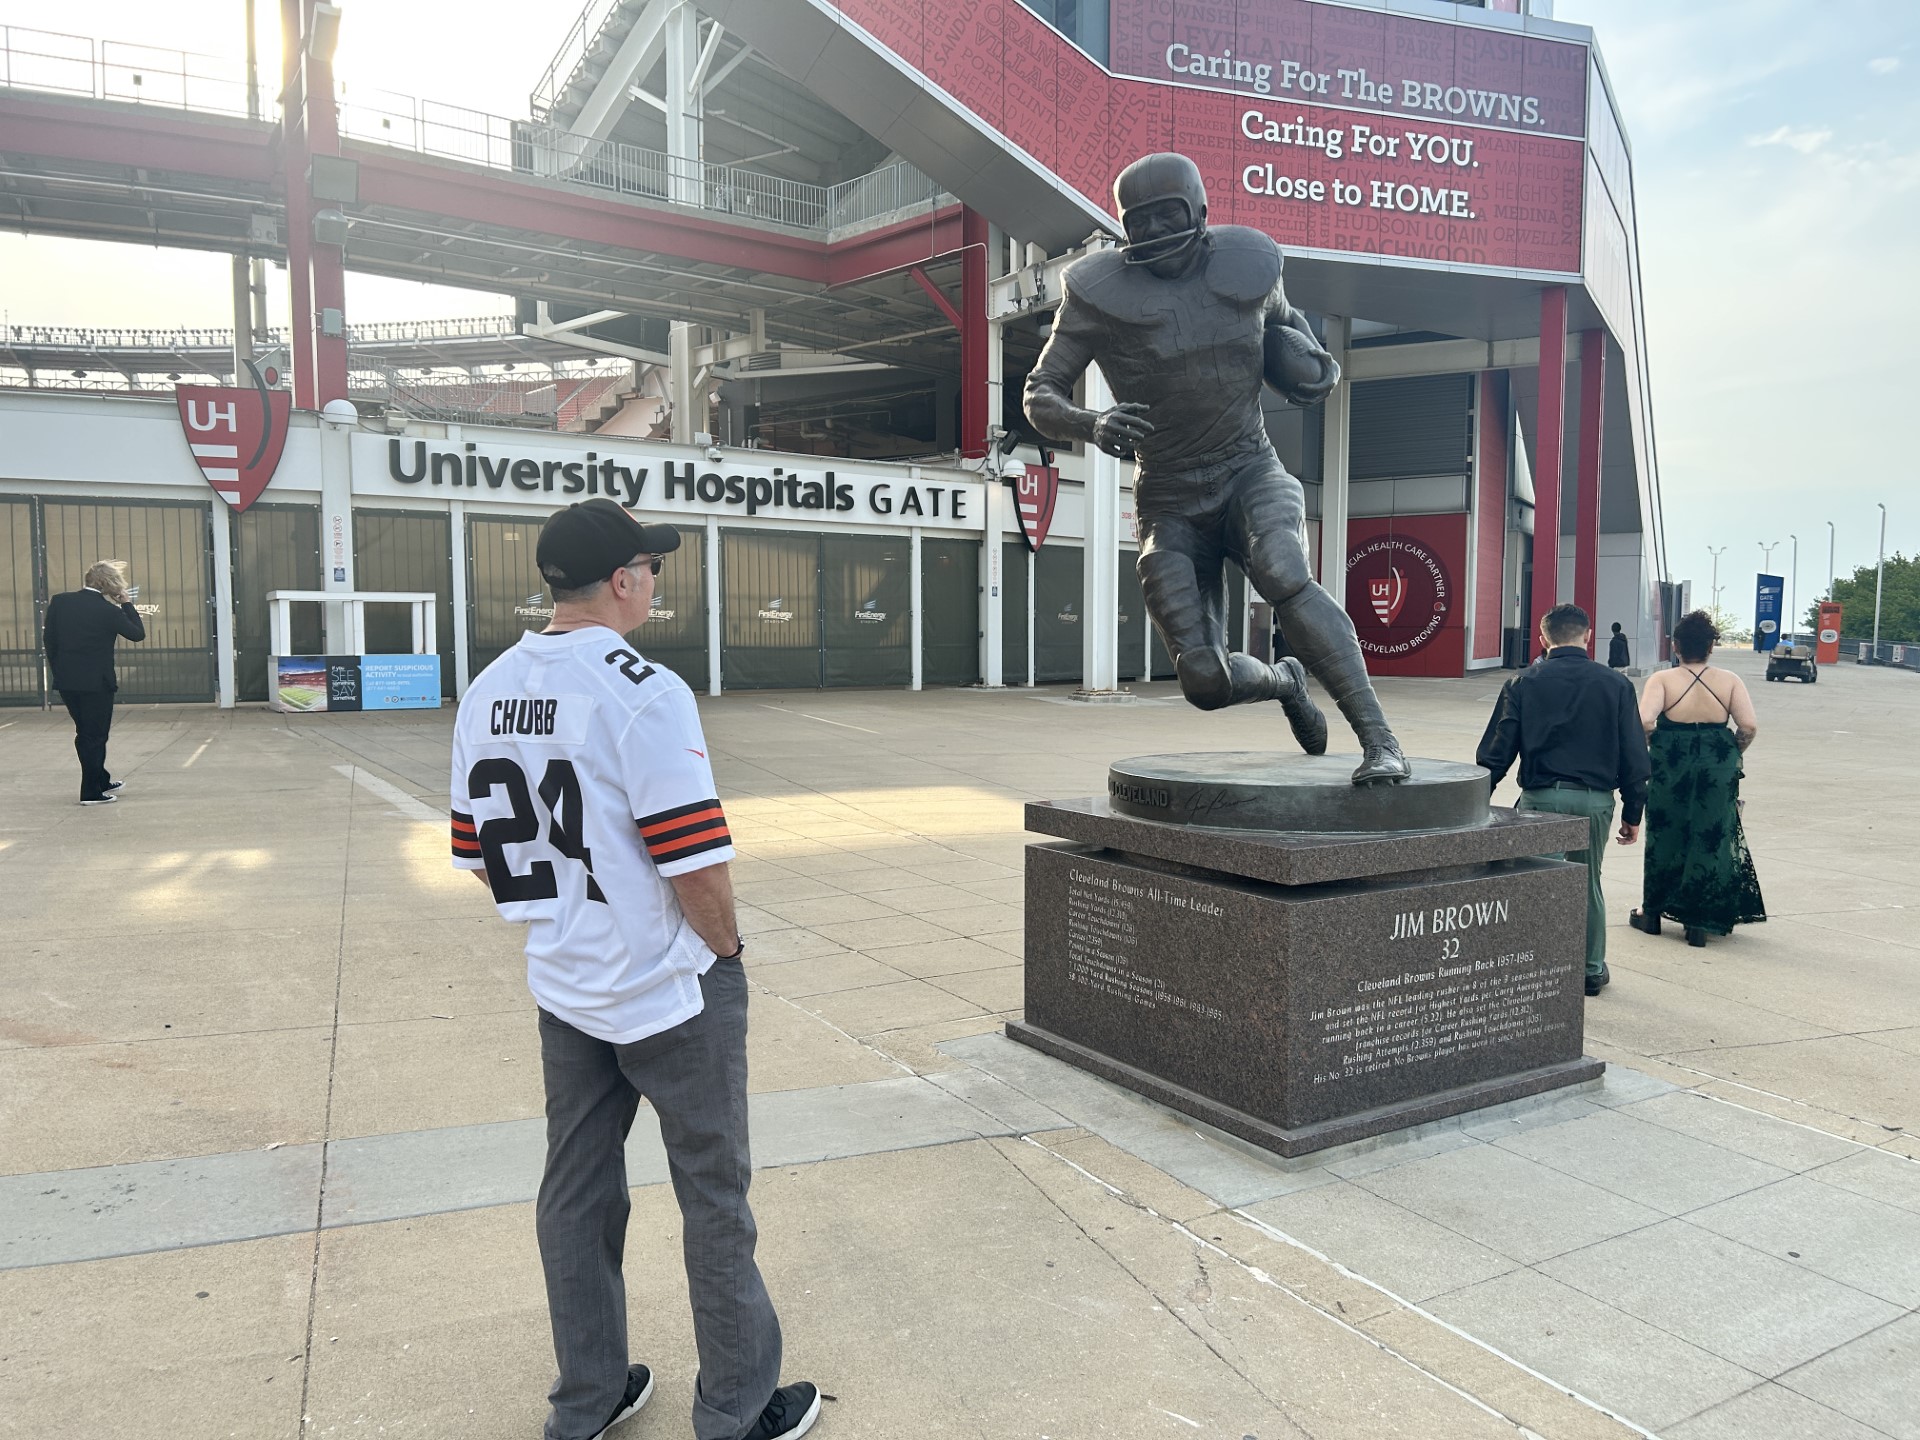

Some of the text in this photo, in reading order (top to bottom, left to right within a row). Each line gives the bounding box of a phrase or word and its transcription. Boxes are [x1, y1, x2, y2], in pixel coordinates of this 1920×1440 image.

[934, 0, 979, 68] SANDUS
[984, 4, 1088, 94] ORANGE
[975, 22, 1077, 115] VILLAGE
[1165, 43, 1273, 94] Caring
[1280, 59, 1331, 95] For
[1337, 68, 1393, 104] The
[1400, 79, 1546, 126] BROWNS.
[1240, 110, 1343, 159] Caring
[1350, 124, 1401, 158] For
[1404, 131, 1479, 169] YOU.
[1242, 162, 1326, 201] Close
[1331, 178, 1362, 206] to
[1369, 180, 1477, 220] HOME.
[1334, 211, 1421, 237] HUDSON
[1425, 222, 1489, 246] LORAIN
[187, 399, 238, 433] UH
[388, 437, 968, 520] University Hospitals GATE
[1017, 473, 1039, 498] UH
[1345, 541, 1446, 599] ICIAL HEALTH CARE PARTNER
[1371, 583, 1390, 597] UH
[1358, 613, 1442, 654] CLEVELAND BROWNS
[331, 669, 355, 682] SEE
[364, 664, 435, 672] REPORT SUSPICIOUS
[364, 671, 398, 679] ACTIVITY
[331, 685, 357, 697] SAY
[489, 697, 559, 737] CHUBB
[466, 756, 610, 906] 24
[1069, 868, 1225, 918] Cleveland Browns All-Time Leader
[1388, 899, 1510, 941] JIM BROWN
[1440, 937, 1461, 961] 32
[1356, 950, 1535, 993] Cleveland Browns Running Back 1957-1965
[1309, 1011, 1325, 1022] Jim
[1326, 1006, 1353, 1019] Brown
[1354, 1003, 1371, 1013] was
[1372, 998, 1386, 1011] the
[1387, 994, 1404, 1007] NFL
[1405, 989, 1435, 1004] leading
[1436, 985, 1461, 998] rusher
[1324, 1019, 1340, 1032] and
[1341, 1016, 1354, 1028] set
[1356, 1013, 1369, 1026] the
[1371, 1010, 1387, 1022] NFL
[1387, 1005, 1414, 1019] record
[1429, 998, 1457, 1012] Highest
[1321, 1031, 1353, 1045] running
[1393, 1018, 1420, 1030] career
[1354, 1037, 1391, 1052] franchise
[1312, 1072, 1328, 1085] His
[1344, 1065, 1355, 1078] 32
[1393, 1055, 1406, 1068] No
[1342, 1053, 1374, 1067] Rushing
[1374, 1045, 1410, 1061] Attempts
